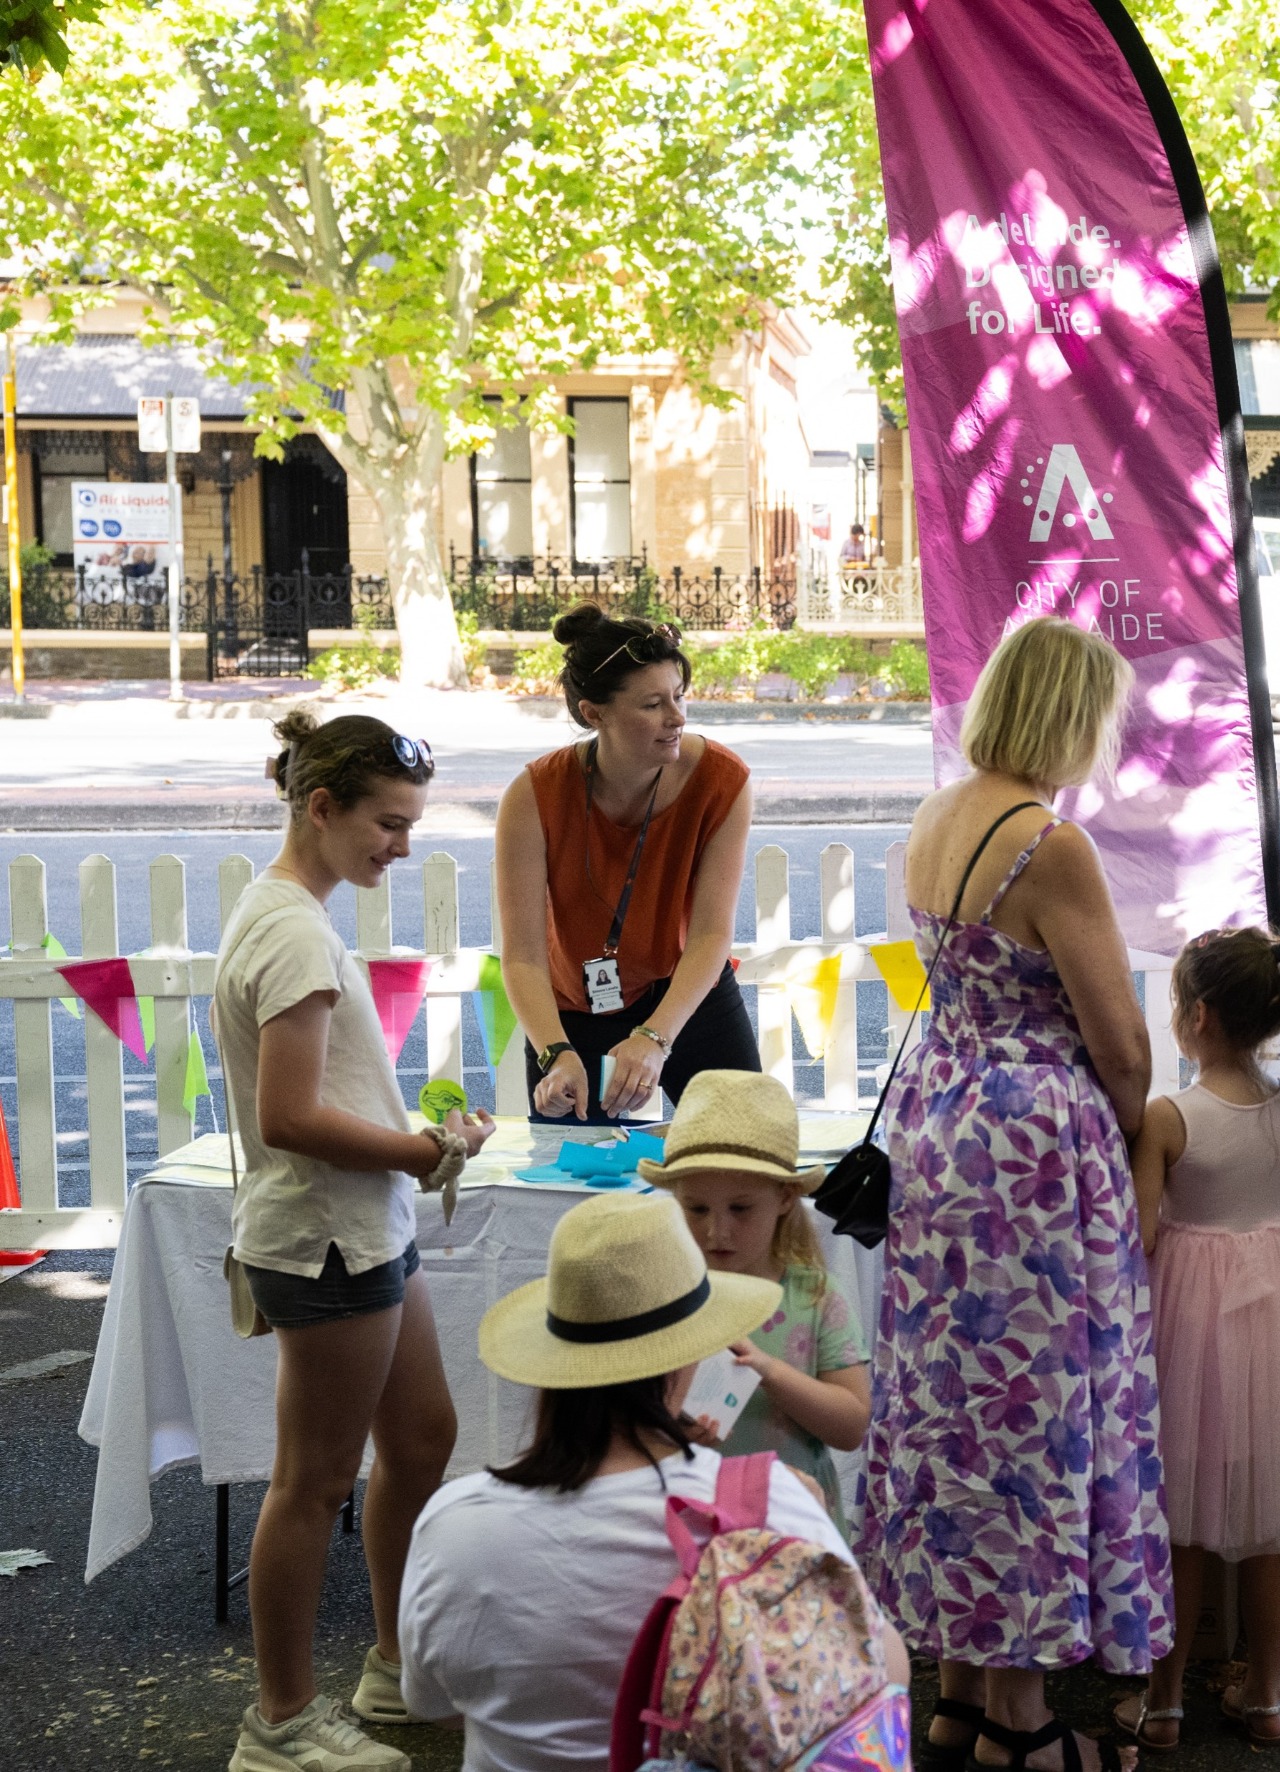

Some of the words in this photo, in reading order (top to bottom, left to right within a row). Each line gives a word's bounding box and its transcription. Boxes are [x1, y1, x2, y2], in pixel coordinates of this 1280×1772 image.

[965, 255, 1120, 297] Dsigned
[1033, 302, 1102, 336] Life.
[1015, 580, 1081, 609] CITY
[1099, 579, 1141, 608] OF
[1000, 612, 1165, 644] AAIDE
